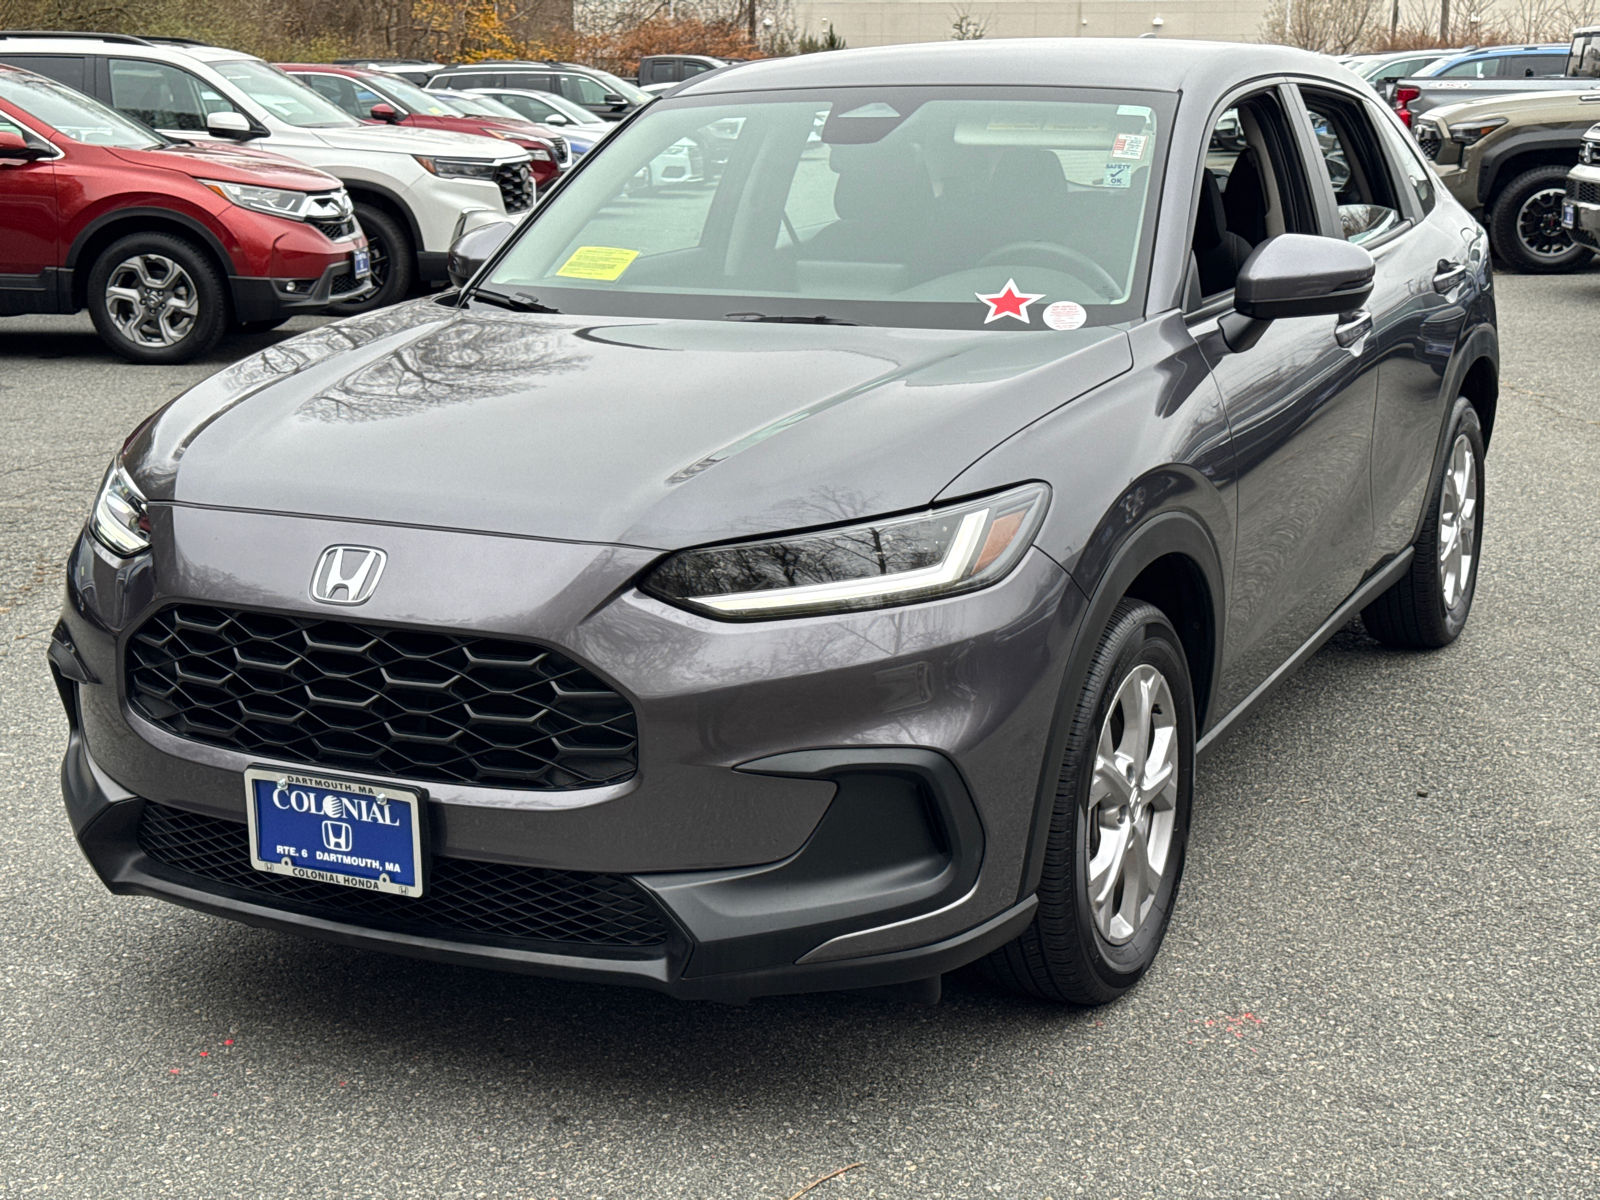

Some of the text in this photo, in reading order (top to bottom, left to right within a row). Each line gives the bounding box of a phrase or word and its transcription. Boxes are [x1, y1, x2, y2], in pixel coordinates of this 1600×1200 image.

[287, 775, 375, 795] DARTMOUTH, MA
[272, 788, 400, 827] COLONIAL
[276, 845, 401, 873] RTE. 6 DARTMOUTH, MA
[292, 868, 380, 890] COLONIAL HONDA
